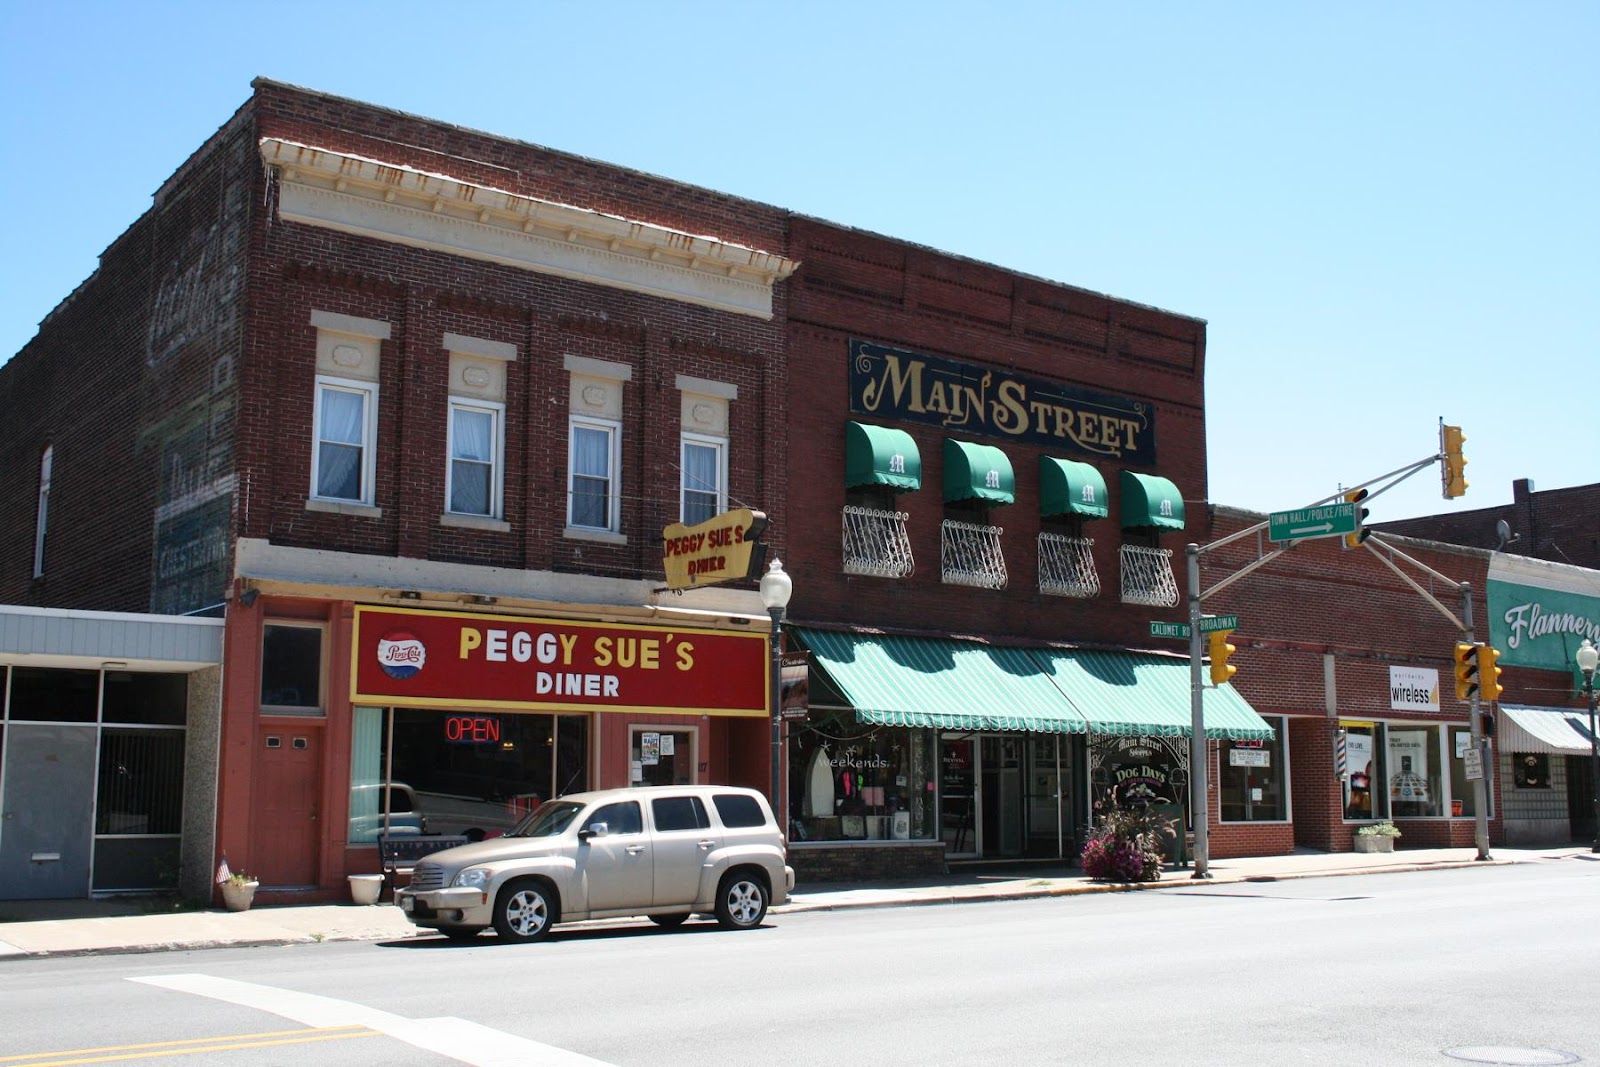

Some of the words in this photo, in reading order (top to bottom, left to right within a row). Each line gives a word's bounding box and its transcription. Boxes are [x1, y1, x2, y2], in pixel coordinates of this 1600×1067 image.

[989, 379, 1141, 458] STREET
[1270, 512, 1288, 526] TOWN
[665, 533, 706, 558] PEGGY
[687, 556, 726, 576] DINER
[1151, 623, 1179, 637] CALUMET
[1182, 624, 1191, 637] RD
[1200, 617, 1238, 631] BROADWAY
[459, 627, 579, 665] PEGGY
[594, 633, 695, 671] SUE'S
[536, 671, 620, 698] DINER
[1391, 682, 1430, 704] wireless
[446, 717, 499, 742] OPEN
[1116, 767, 1139, 783] DOG
[1141, 765, 1166, 784] DAYS
